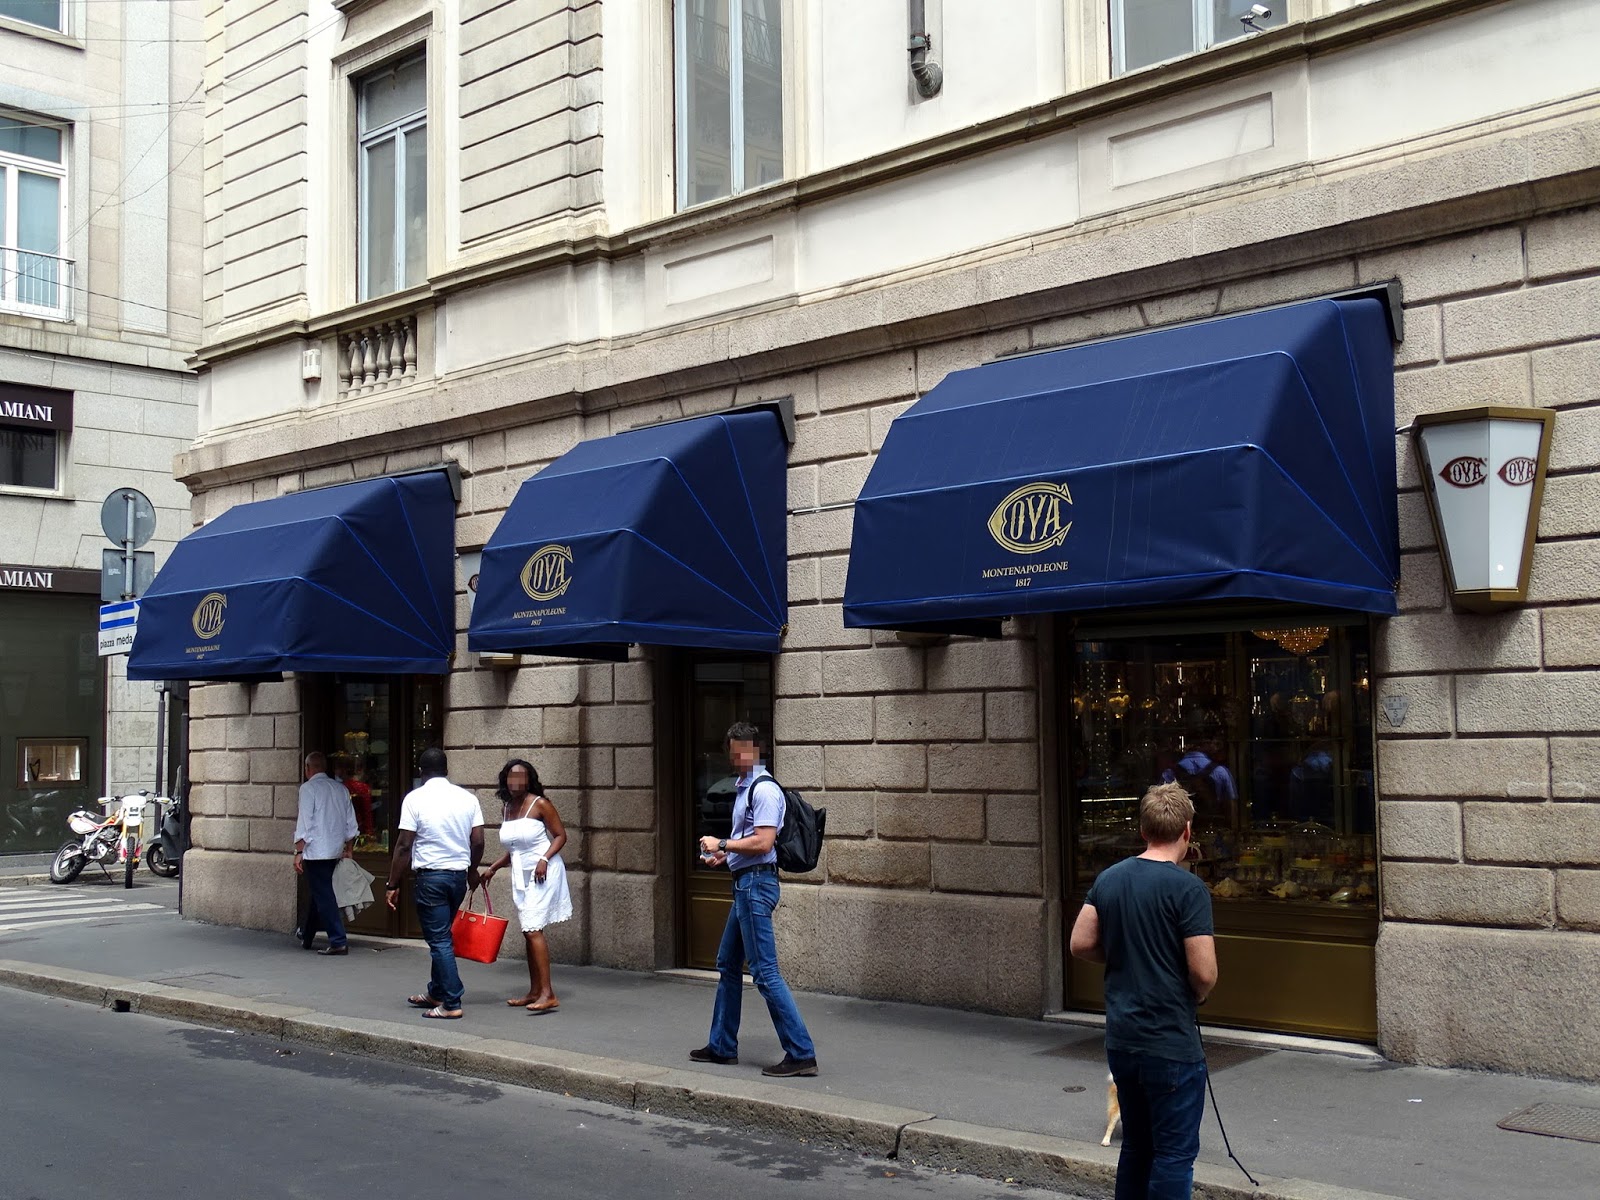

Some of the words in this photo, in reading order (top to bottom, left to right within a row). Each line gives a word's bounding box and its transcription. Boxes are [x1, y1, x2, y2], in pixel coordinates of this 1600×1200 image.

[982, 561, 1069, 578] MONTENAPOLEONE
[1015, 578, 1031, 587] 1817
[512, 607, 567, 619] MONTENAPOLEONE
[100, 639, 115, 650] piazza
[116, 633, 133, 646] meda
